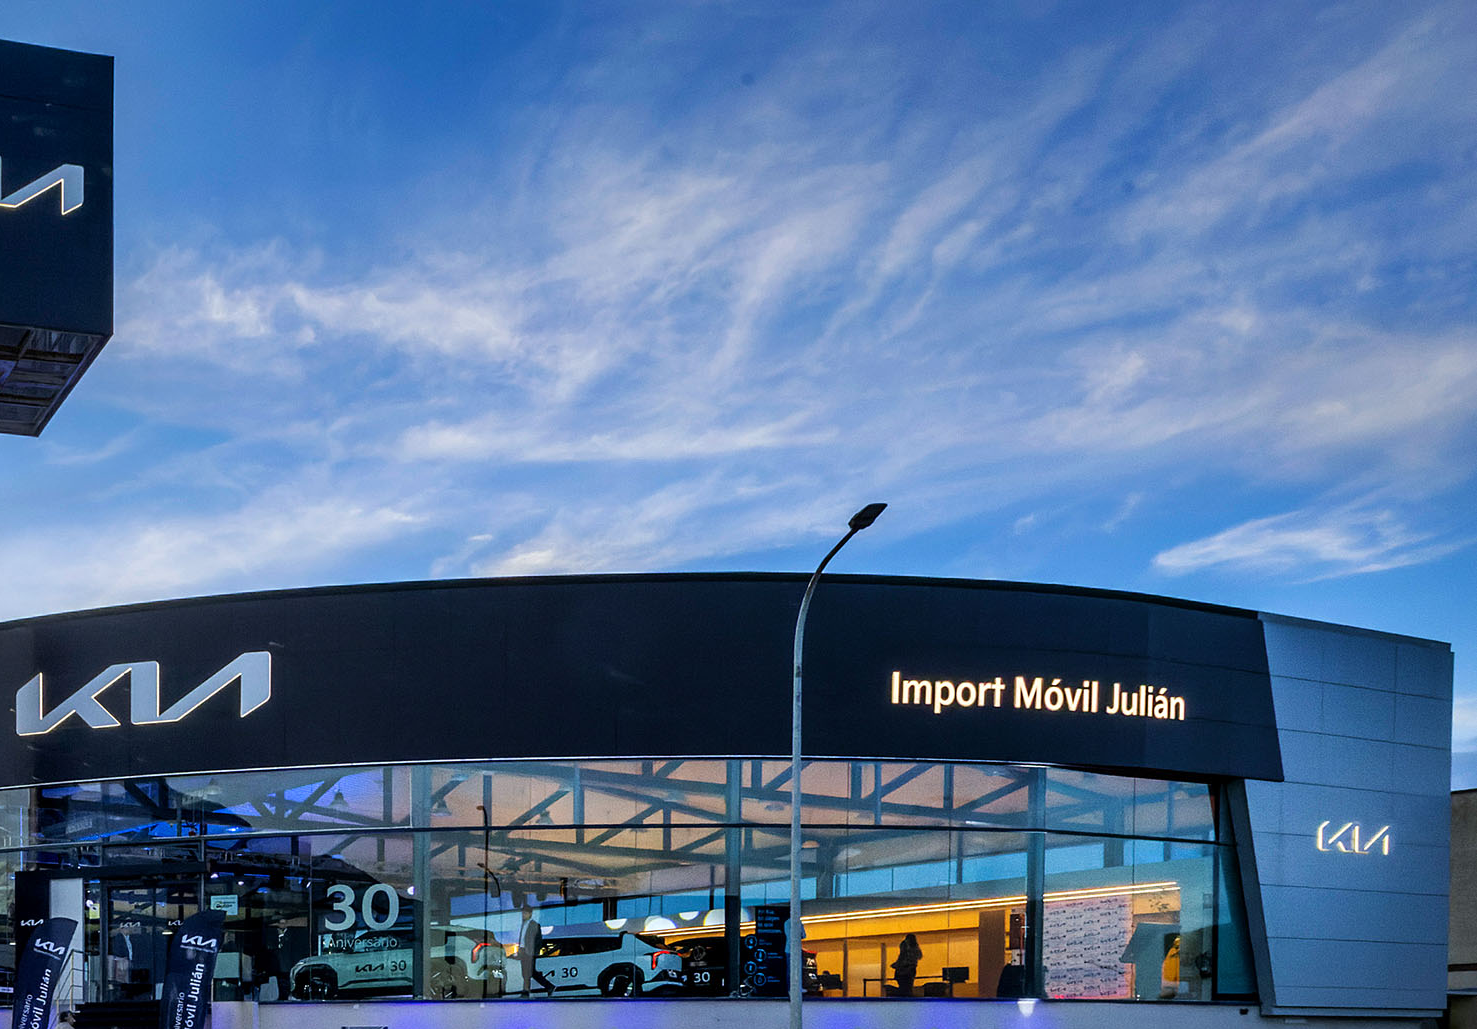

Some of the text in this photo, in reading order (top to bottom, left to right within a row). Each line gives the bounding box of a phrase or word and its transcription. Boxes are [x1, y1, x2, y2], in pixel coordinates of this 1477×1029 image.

[16, 650, 271, 736] KIA
[891, 671, 1186, 721] Import Móvil Julián
[1316, 820, 1391, 856] KIA
[325, 883, 400, 931] 30
[21, 919, 44, 927] KIA
[35, 938, 65, 955] KIA
[181, 933, 217, 948] KIA
[328, 936, 398, 948] Aniversario
[355, 960, 407, 973] KIA 30
[561, 967, 578, 978] 30
[192, 963, 205, 1003] Julián
[693, 971, 711, 984] 30
[36, 968, 52, 1006] Julián
